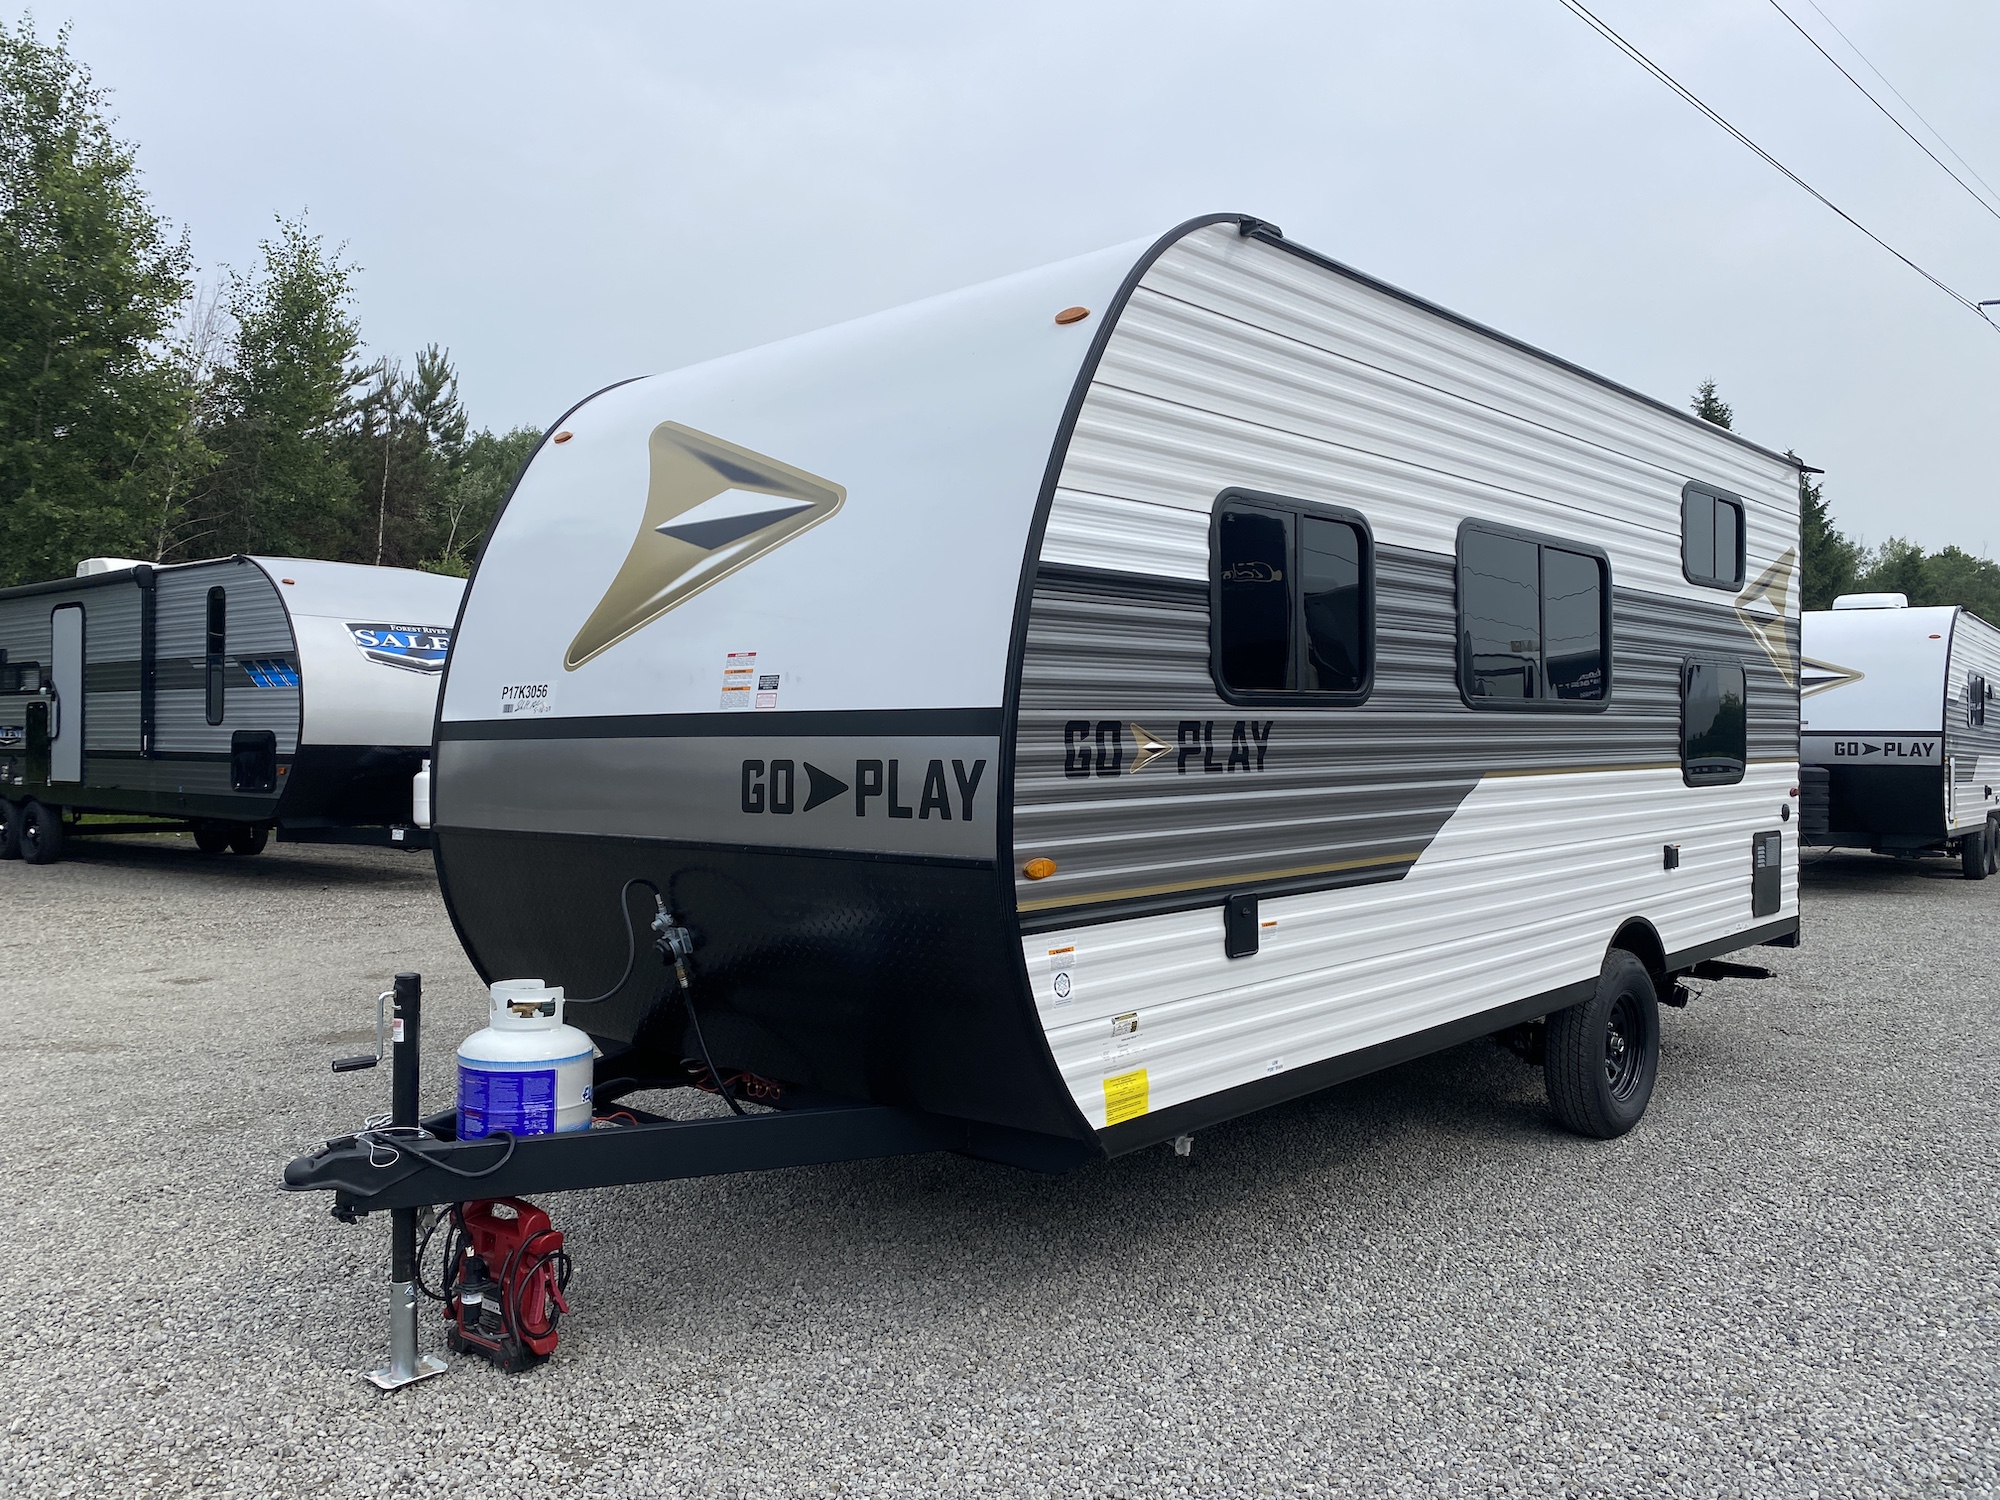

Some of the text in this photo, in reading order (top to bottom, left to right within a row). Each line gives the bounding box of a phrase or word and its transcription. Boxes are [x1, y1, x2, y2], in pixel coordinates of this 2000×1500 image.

[390, 625, 448, 635] FOREST RIVER
[354, 629, 450, 651] SALE
[501, 684, 548, 700] P17K3056
[1064, 720, 1274, 779] GO PLAY
[1834, 742, 1935, 757] GO PLAY
[742, 759, 987, 821] GO PLAY
